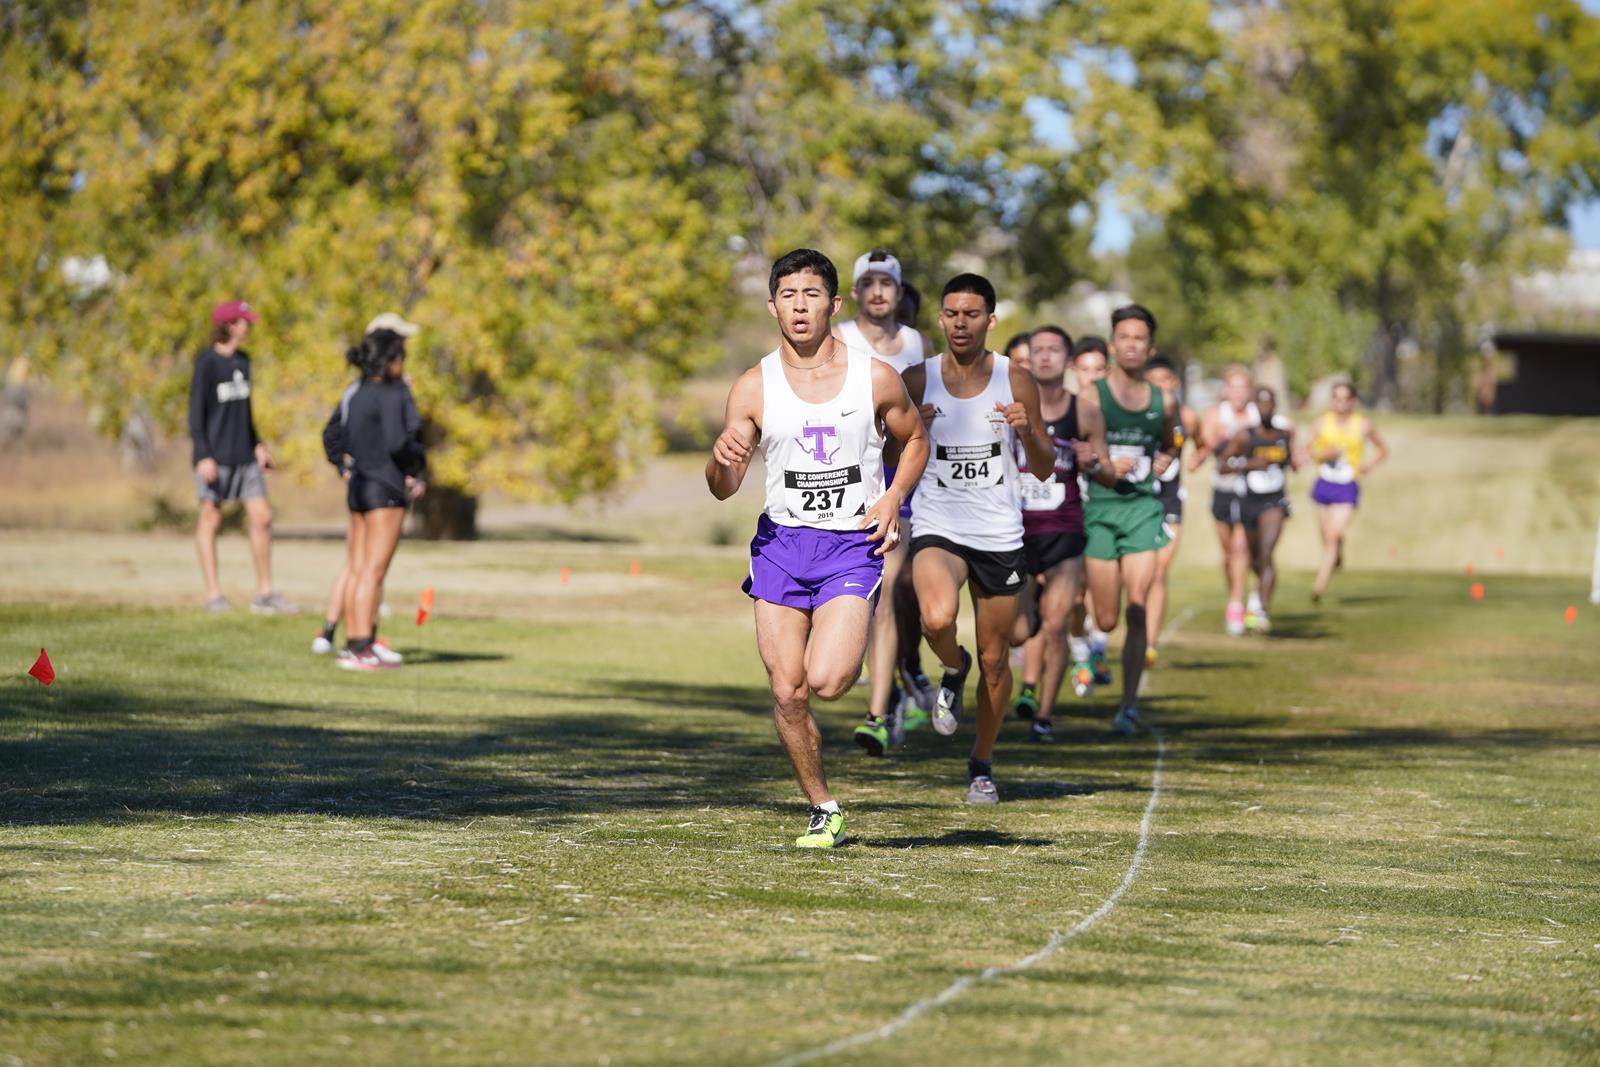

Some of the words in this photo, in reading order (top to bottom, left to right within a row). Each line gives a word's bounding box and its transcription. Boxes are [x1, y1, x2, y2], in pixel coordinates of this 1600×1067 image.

[807, 469, 848, 480] CONFERENCE
[951, 461, 990, 480] 264
[797, 477, 848, 487] CHAMPIONSHIPS
[801, 487, 846, 511] 237
